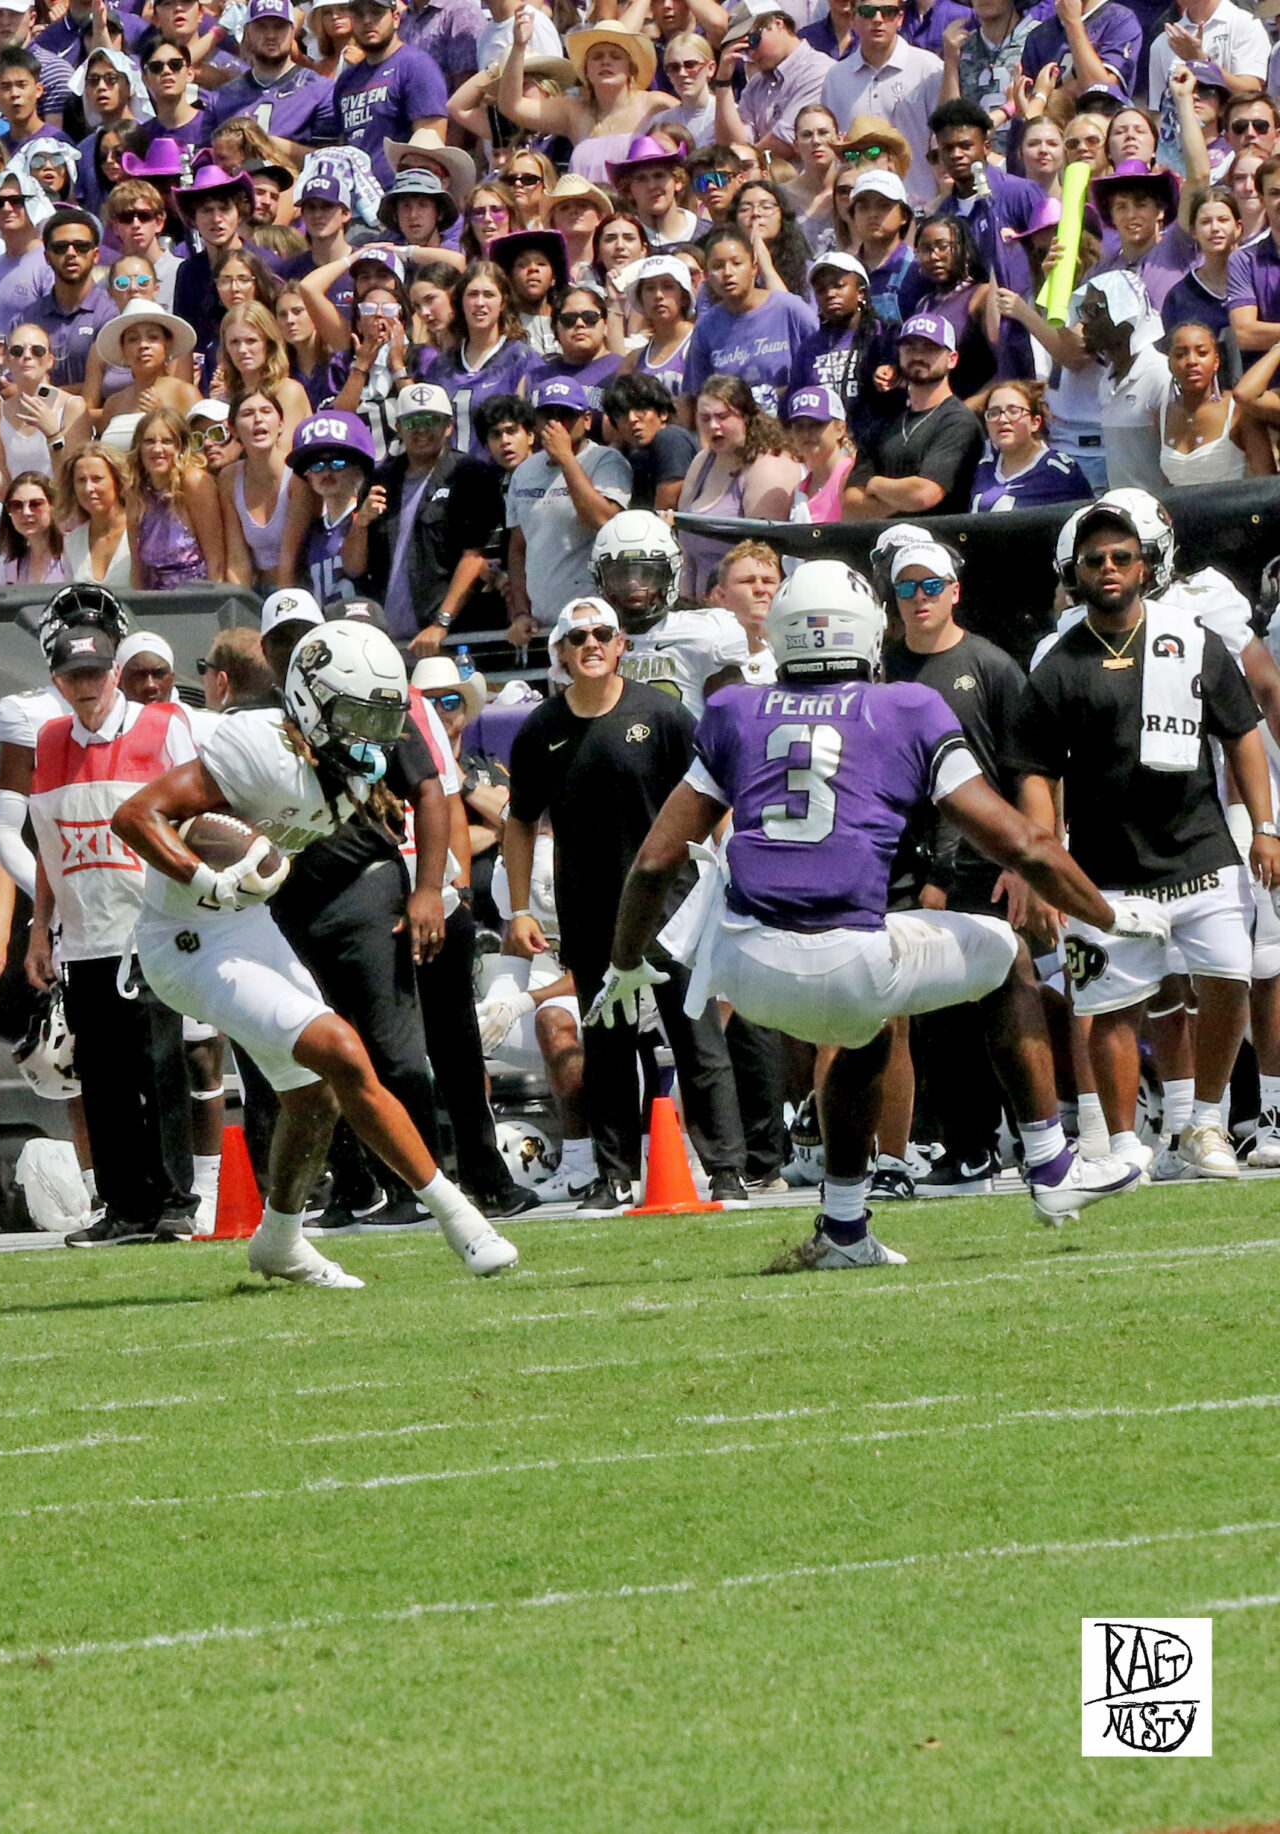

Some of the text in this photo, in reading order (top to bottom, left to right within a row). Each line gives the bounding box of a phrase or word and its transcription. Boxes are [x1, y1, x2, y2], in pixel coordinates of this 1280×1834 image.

[340, 91, 367, 113] GIVE
[344, 105, 373, 128] HELL
[907, 318, 938, 334] TCU
[711, 337, 790, 368] Funky Town
[545, 383, 570, 396] TCU
[792, 393, 821, 411] TCU
[301, 417, 349, 445] TCU
[813, 630, 825, 648] 3
[787, 661, 823, 674] HORNED
[764, 690, 859, 717] PERRY
[760, 723, 844, 843] 3
